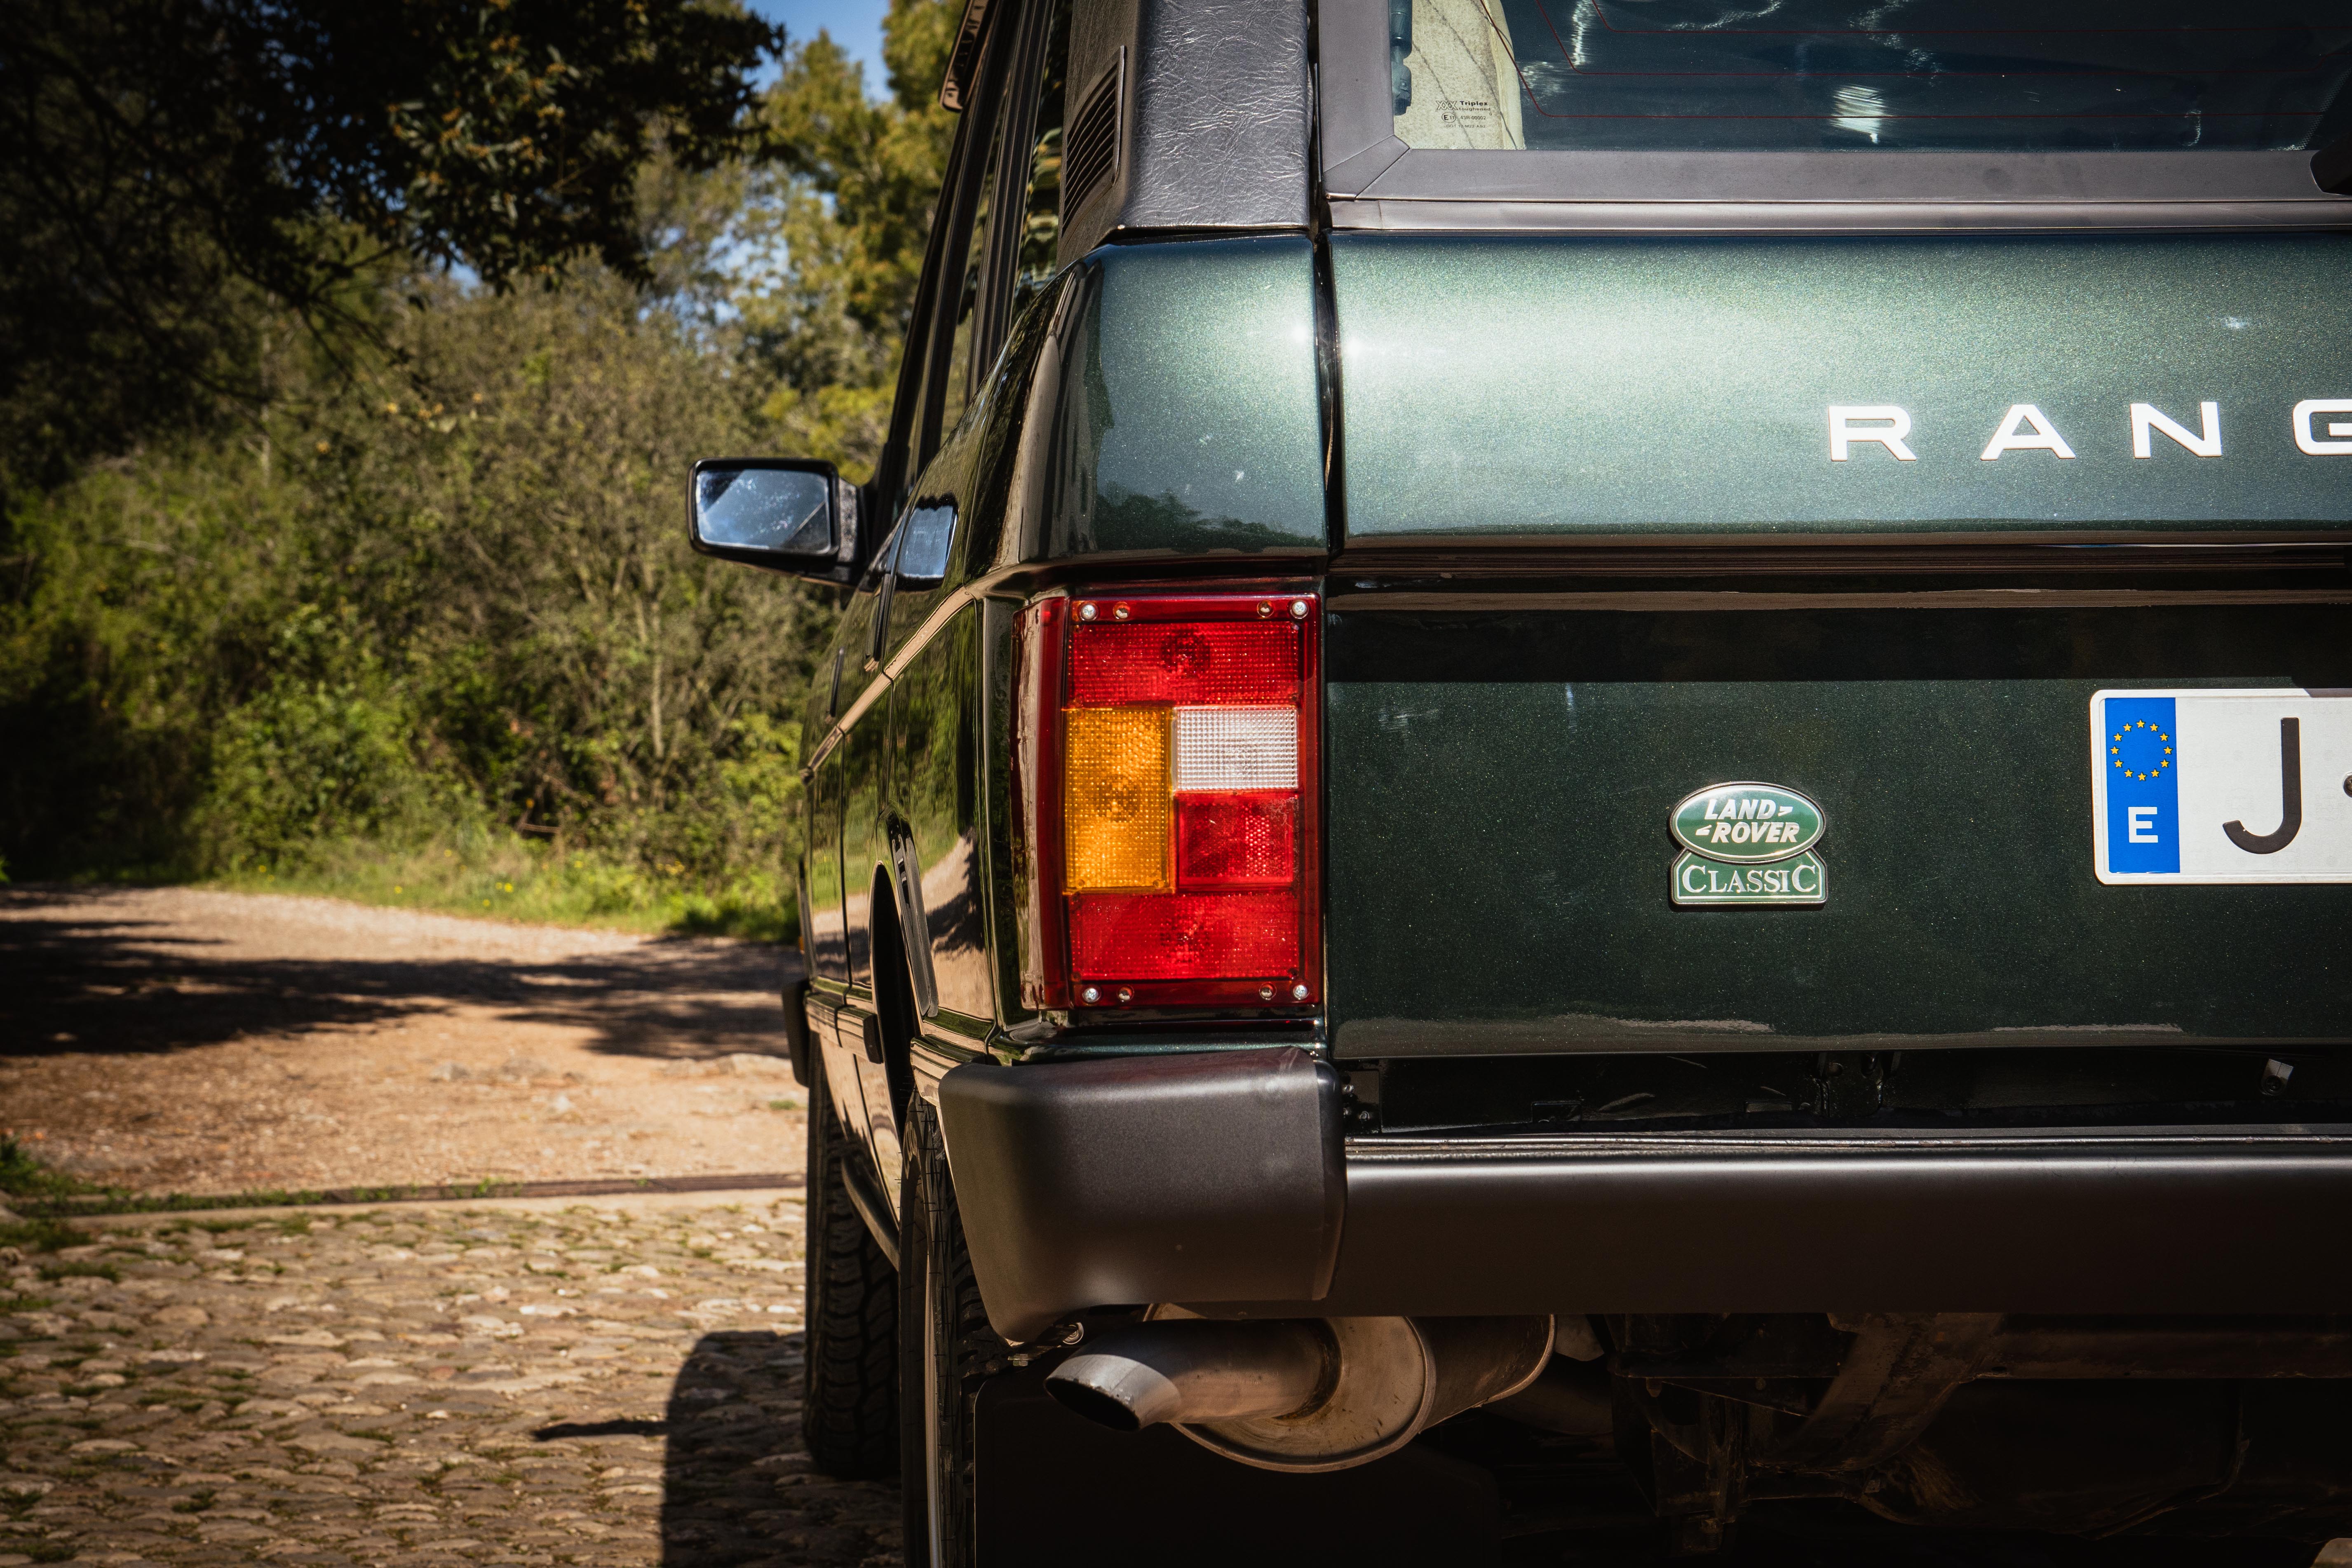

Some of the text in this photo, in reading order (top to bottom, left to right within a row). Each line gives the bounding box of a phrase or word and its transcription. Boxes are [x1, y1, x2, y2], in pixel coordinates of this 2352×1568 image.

[1828, 399, 2352, 462] RANG
[1704, 799, 1776, 819] LAND
[1711, 822, 1800, 843] ROVER
[2128, 806, 2158, 843] E
[1682, 865, 1816, 893] CLASSIC
